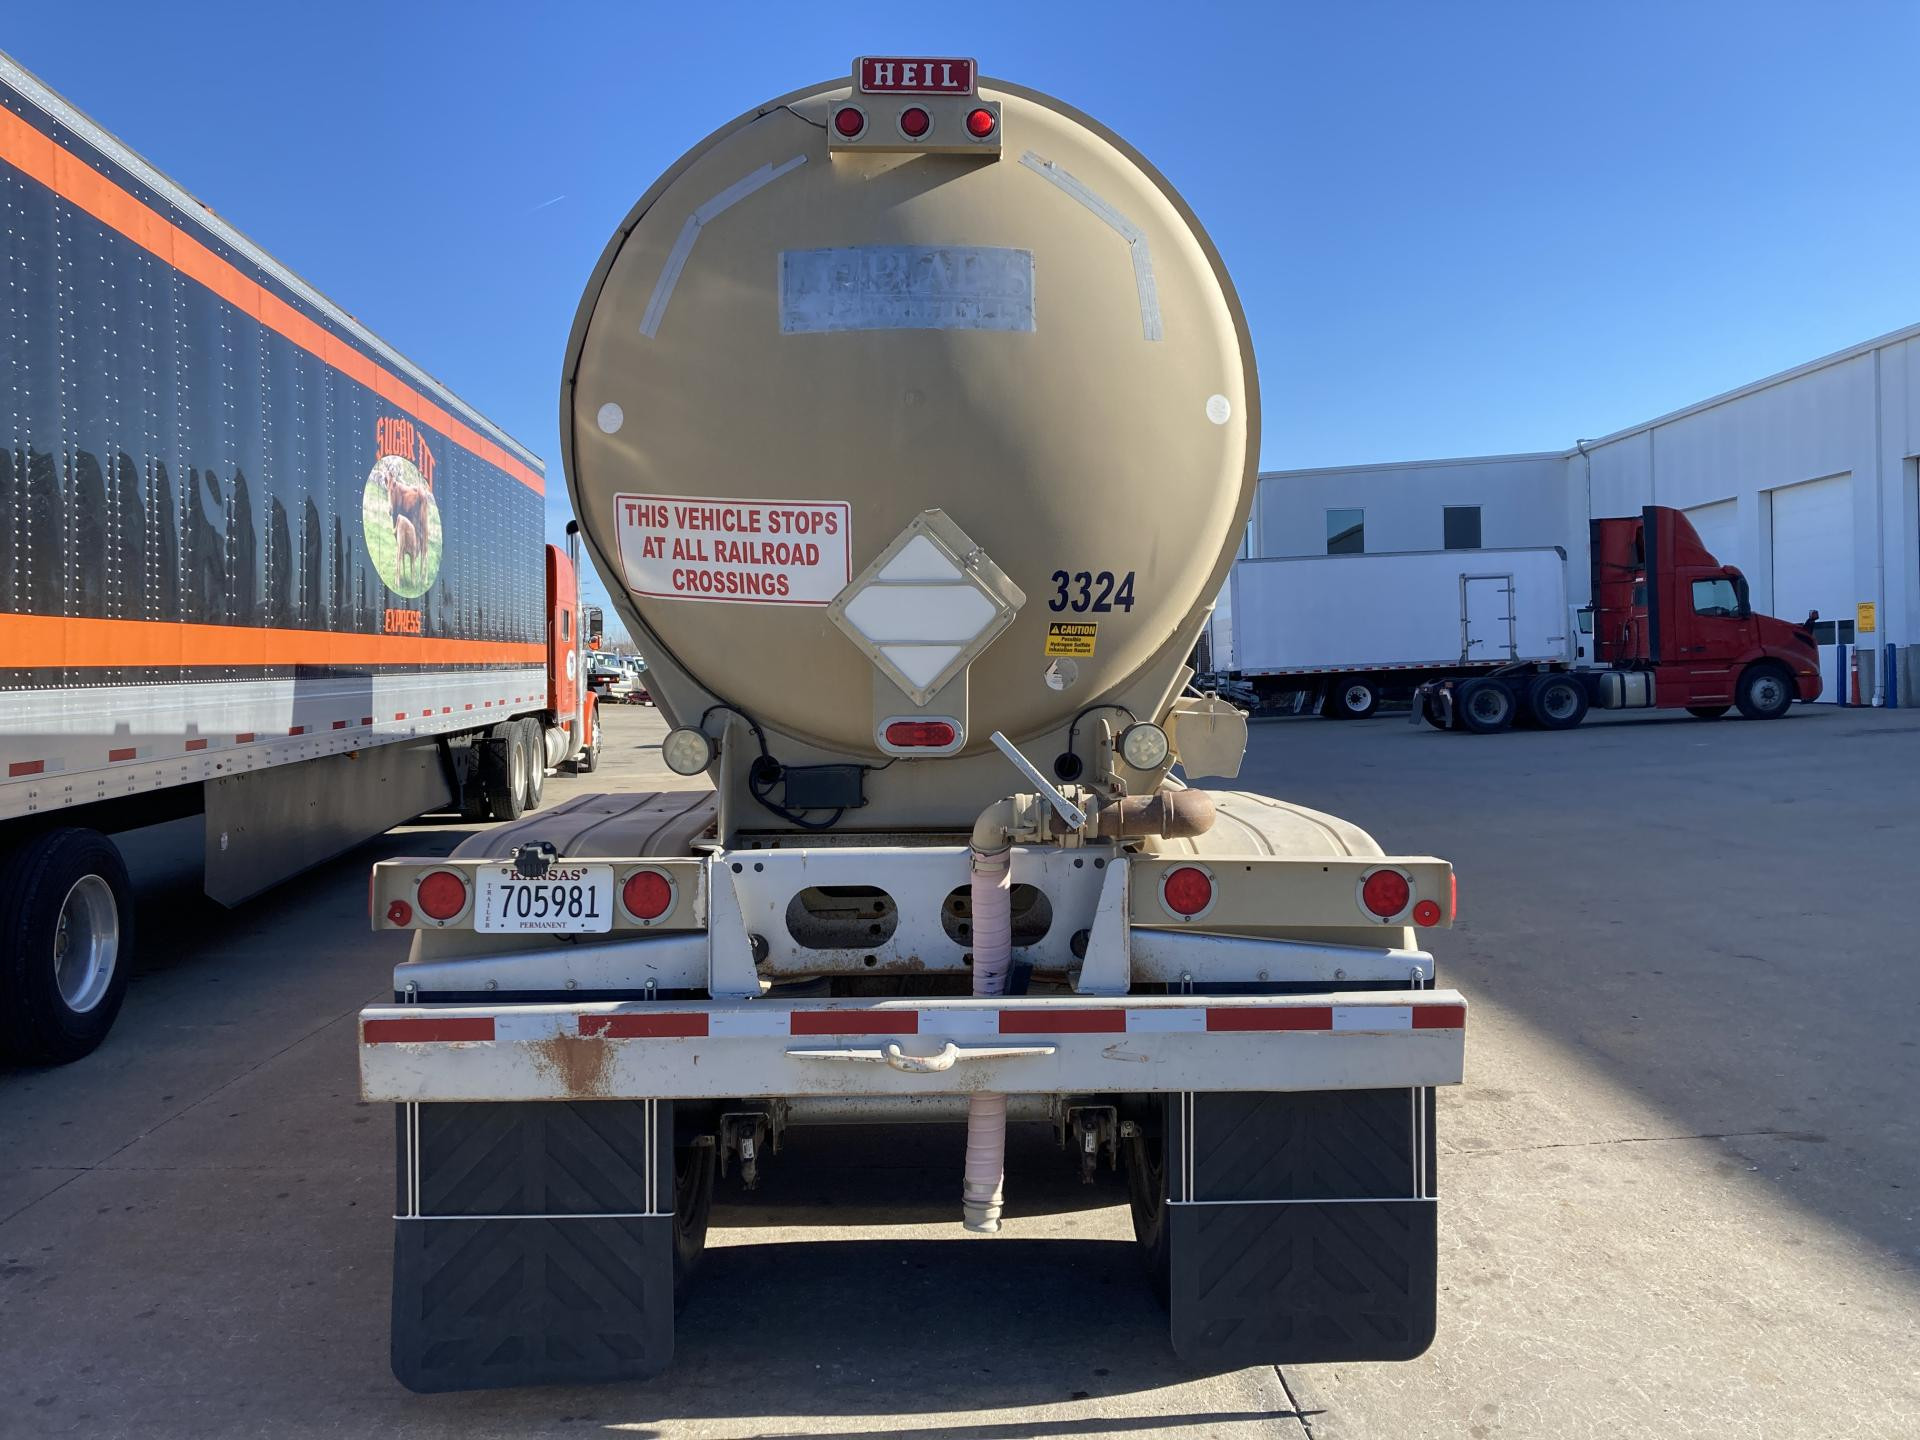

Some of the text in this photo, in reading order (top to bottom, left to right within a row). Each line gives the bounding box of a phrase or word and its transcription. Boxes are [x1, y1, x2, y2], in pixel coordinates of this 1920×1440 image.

[874, 63, 958, 87] HEIL
[376, 417, 436, 493] SUGAR TIT
[625, 504, 838, 535] THIS VEHICLE STOPS
[642, 536, 820, 566] AT ALL RAILROAD
[672, 568, 789, 596] CROSSINGS
[1048, 570, 1136, 613] 3324
[385, 608, 421, 633] EXPRESS
[1060, 625, 1096, 635] CAUTION
[509, 869, 581, 881] KSAS
[500, 885, 600, 918] 705981
[519, 921, 568, 929] PERMANENT
